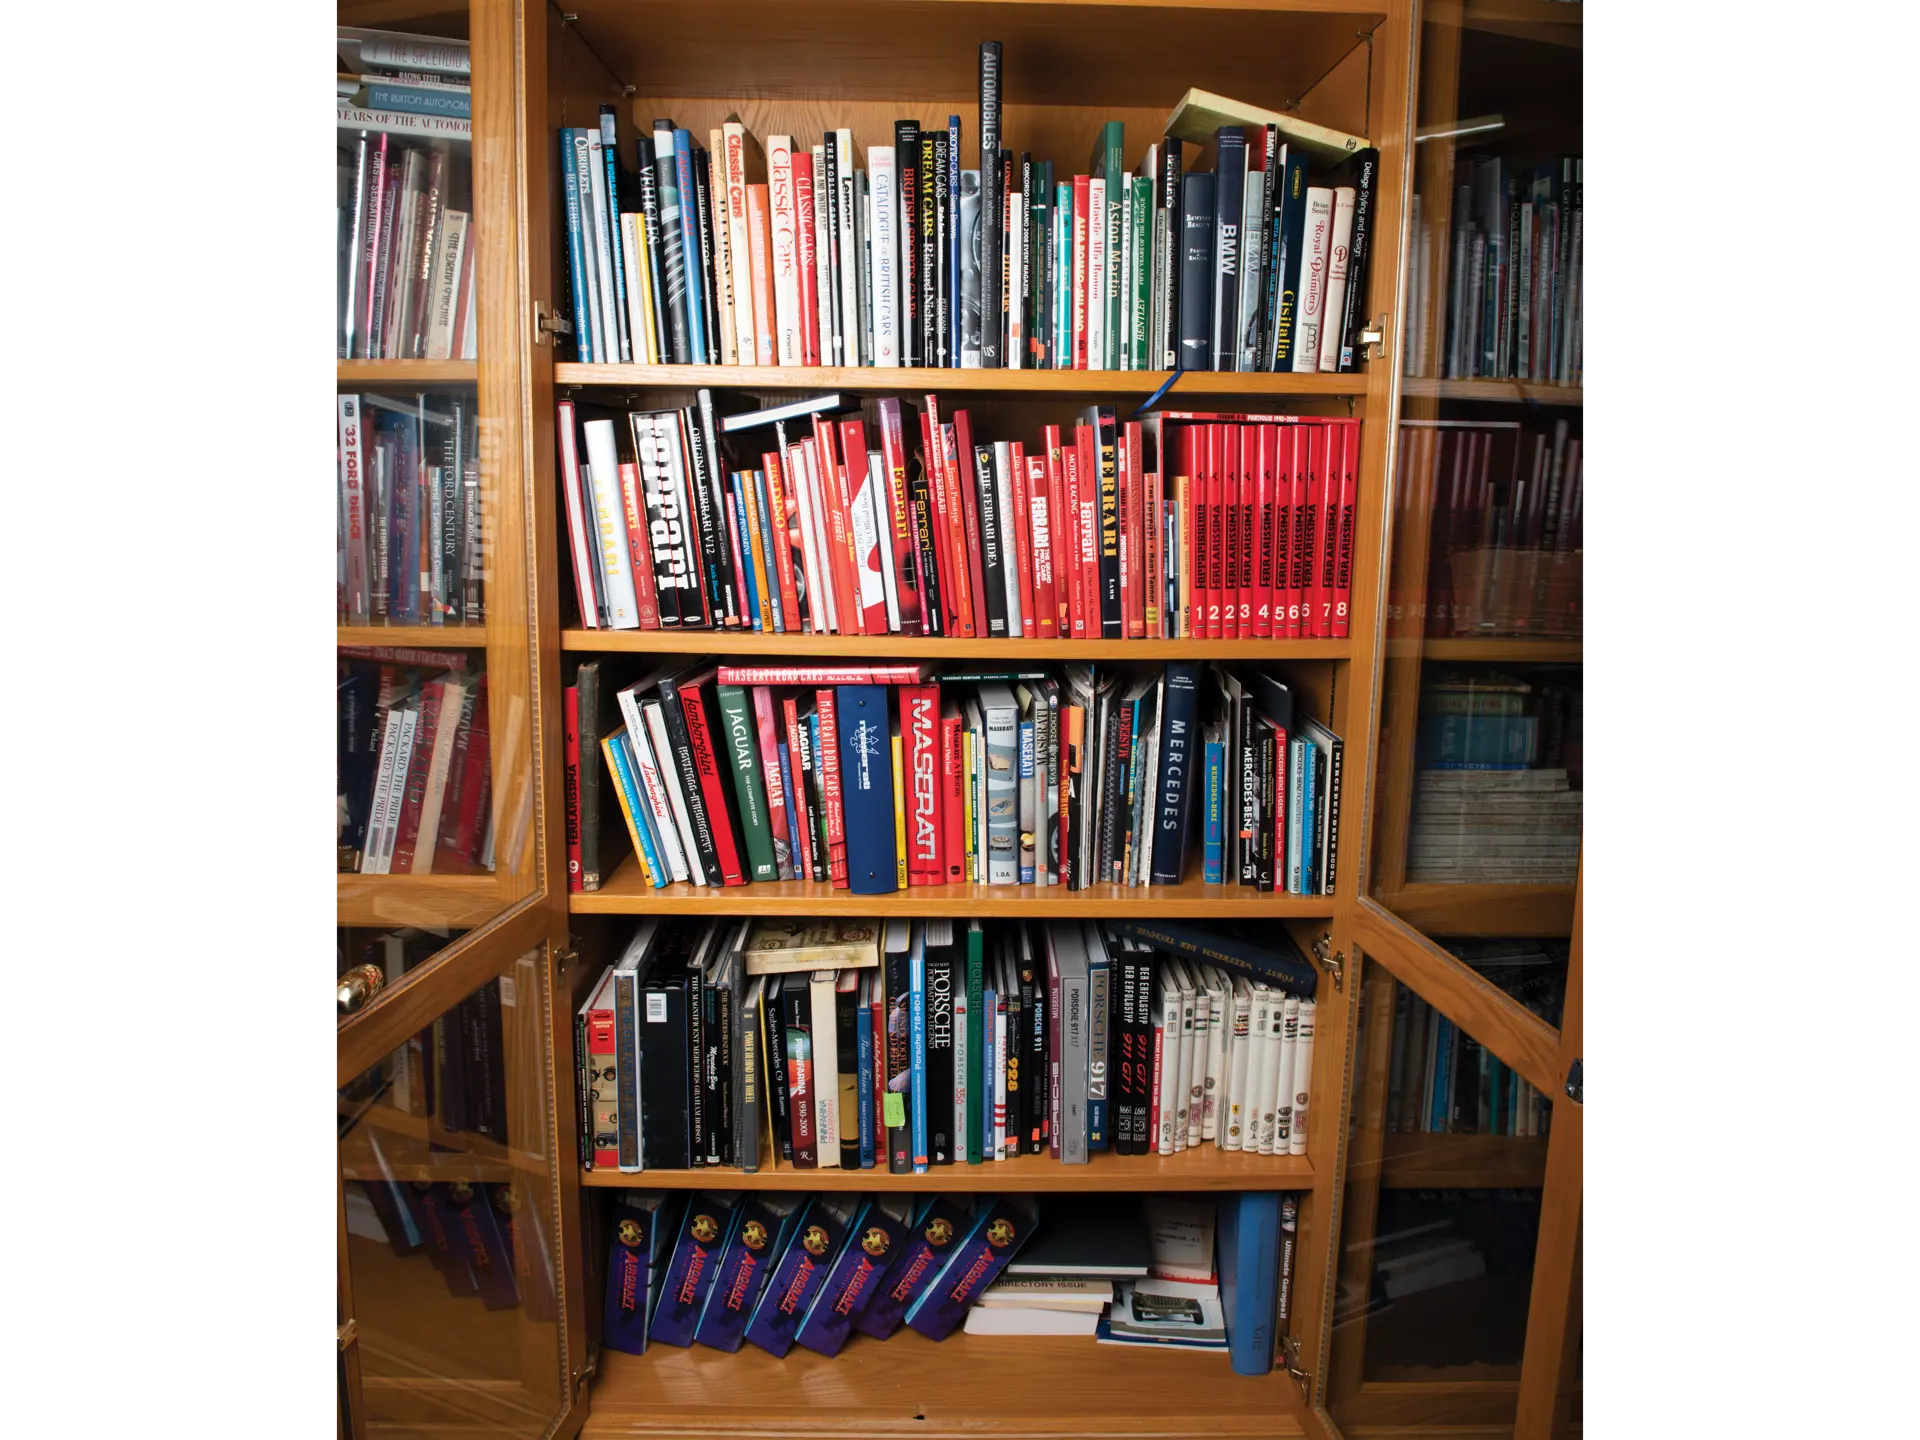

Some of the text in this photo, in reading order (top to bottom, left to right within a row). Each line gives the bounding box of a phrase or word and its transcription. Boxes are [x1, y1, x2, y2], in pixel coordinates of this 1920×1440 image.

[335, 109, 373, 122] YEARS
[376, 114, 389, 124] OF
[394, 115, 416, 127] THE
[982, 52, 996, 225] AUTOMOBILES elegance on wheels
[1266, 131, 1275, 158] BMW
[575, 137, 589, 193] CABRIOLETS
[728, 134, 743, 219] Classic Cars
[1166, 154, 1176, 208] BENTLEYS
[639, 165, 659, 245] VEHICLES
[771, 147, 794, 277] Classic Cars
[842, 177, 852, 230] Lemons
[1354, 162, 1372, 257] Delage Styling and Design
[922, 140, 933, 336] DREAM CARS Richard Nichols
[1092, 187, 1103, 299] Fantastic Alfa Romeo
[1108, 201, 1121, 298] Aston Martin
[1222, 225, 1237, 274] BMW
[1248, 231, 1259, 274] BMW
[1510, 203, 1520, 321] HOMETOWN DINERS
[1304, 220, 1324, 316] Royal Daimlers
[1541, 236, 1549, 299] AIRSTREAM
[1277, 290, 1294, 360] Cisitalia
[347, 451, 357, 489] FORD
[444, 439, 455, 556] THE FORD CENTURY
[691, 428, 715, 554] ORIGINAL FERRARI V12
[947, 468, 960, 524] Ferrari Prototype
[1068, 454, 1078, 514] MOTOR RACING
[349, 495, 361, 540] DEUCE
[637, 418, 697, 590] Ferrari
[832, 510, 844, 543] Ferrari
[892, 466, 910, 540] Ferrari
[916, 489, 931, 551] Ferrari
[981, 468, 996, 568] THE FERRARI IDEA
[1031, 496, 1050, 548] FERRARI
[1101, 445, 1116, 557] FERRARI
[1080, 501, 1096, 563] Ferrari
[1196, 606, 1203, 620] 1
[1209, 606, 1218, 620] 2
[1225, 605, 1234, 619] 2
[1241, 605, 1250, 618] 3
[1259, 604, 1268, 618] 4
[1275, 606, 1284, 620] 5
[1289, 605, 1299, 619] 6
[1301, 603, 1309, 617] 6
[1323, 603, 1331, 617] 7
[1336, 602, 1346, 616] 8
[684, 698, 714, 777] Lamborghini
[726, 709, 752, 770] JAGUAR
[745, 785, 754, 810] COMPLETE
[798, 724, 811, 770] JAGUAR
[820, 701, 838, 797] MASERATI ROAD CARS
[1022, 728, 1033, 776] MASERATI
[1036, 708, 1047, 765] MASERATI
[1119, 707, 1132, 759] MASERATI
[374, 723, 397, 825] PACKARD: THE PRIDE
[388, 723, 412, 824] PACKARD: THE PRIDE
[641, 762, 665, 818] Lamborghini
[764, 760, 783, 807] JAGUAR
[912, 698, 936, 860] MASERATI
[1163, 720, 1186, 830] MERCEDES
[1331, 752, 1340, 849] MERCEDES-BENZ
[569, 860, 579, 873] 9
[1329, 871, 1334, 880] SL
[928, 1002, 934, 1012] OF
[935, 968, 950, 1049] PORSCHE
[971, 961, 982, 1015] PORSCHE
[692, 993, 700, 1043] MAGNIFICENT
[768, 1008, 782, 1069] Sauber-Mercedes
[913, 994, 922, 1070] Porsche 718+804
[1034, 1037, 1042, 1052] 911
[1071, 989, 1079, 1047] PORSCHE 917 X17
[1090, 974, 1105, 1097] PORSCHE 917
[775, 1070, 783, 1081] C9
[794, 1038, 808, 1136] PININFARINA 1930-2000
[956, 1043, 965, 1105] PORSCHE 356
[1008, 1057, 1018, 1091] 928
[778, 1098, 786, 1116] Bamsey
[1057, 1280, 1086, 1289] ISSUE
